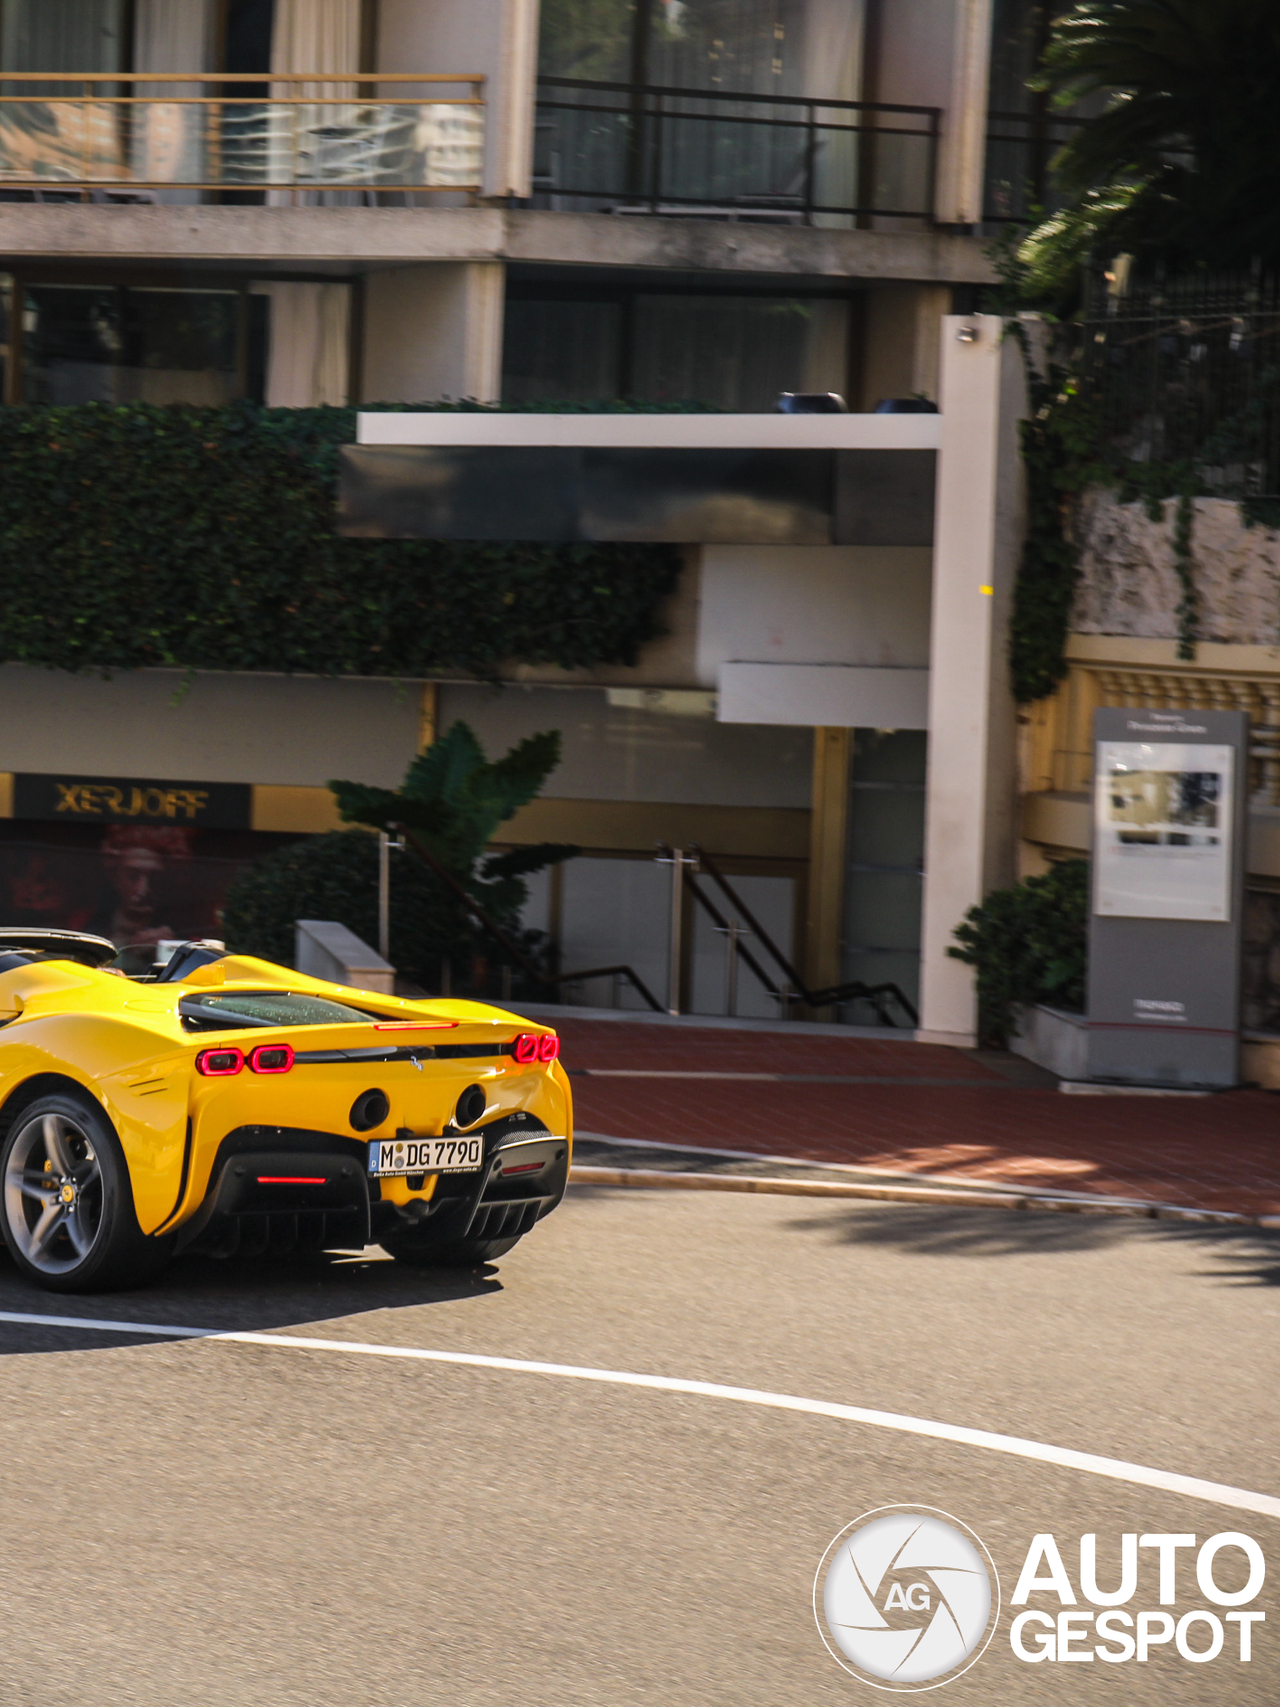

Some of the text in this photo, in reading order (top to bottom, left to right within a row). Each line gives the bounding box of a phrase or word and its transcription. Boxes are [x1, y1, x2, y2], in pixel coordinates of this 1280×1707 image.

[55, 783, 210, 818] XERJOFF
[381, 1140, 479, 1168] M DG 7790
